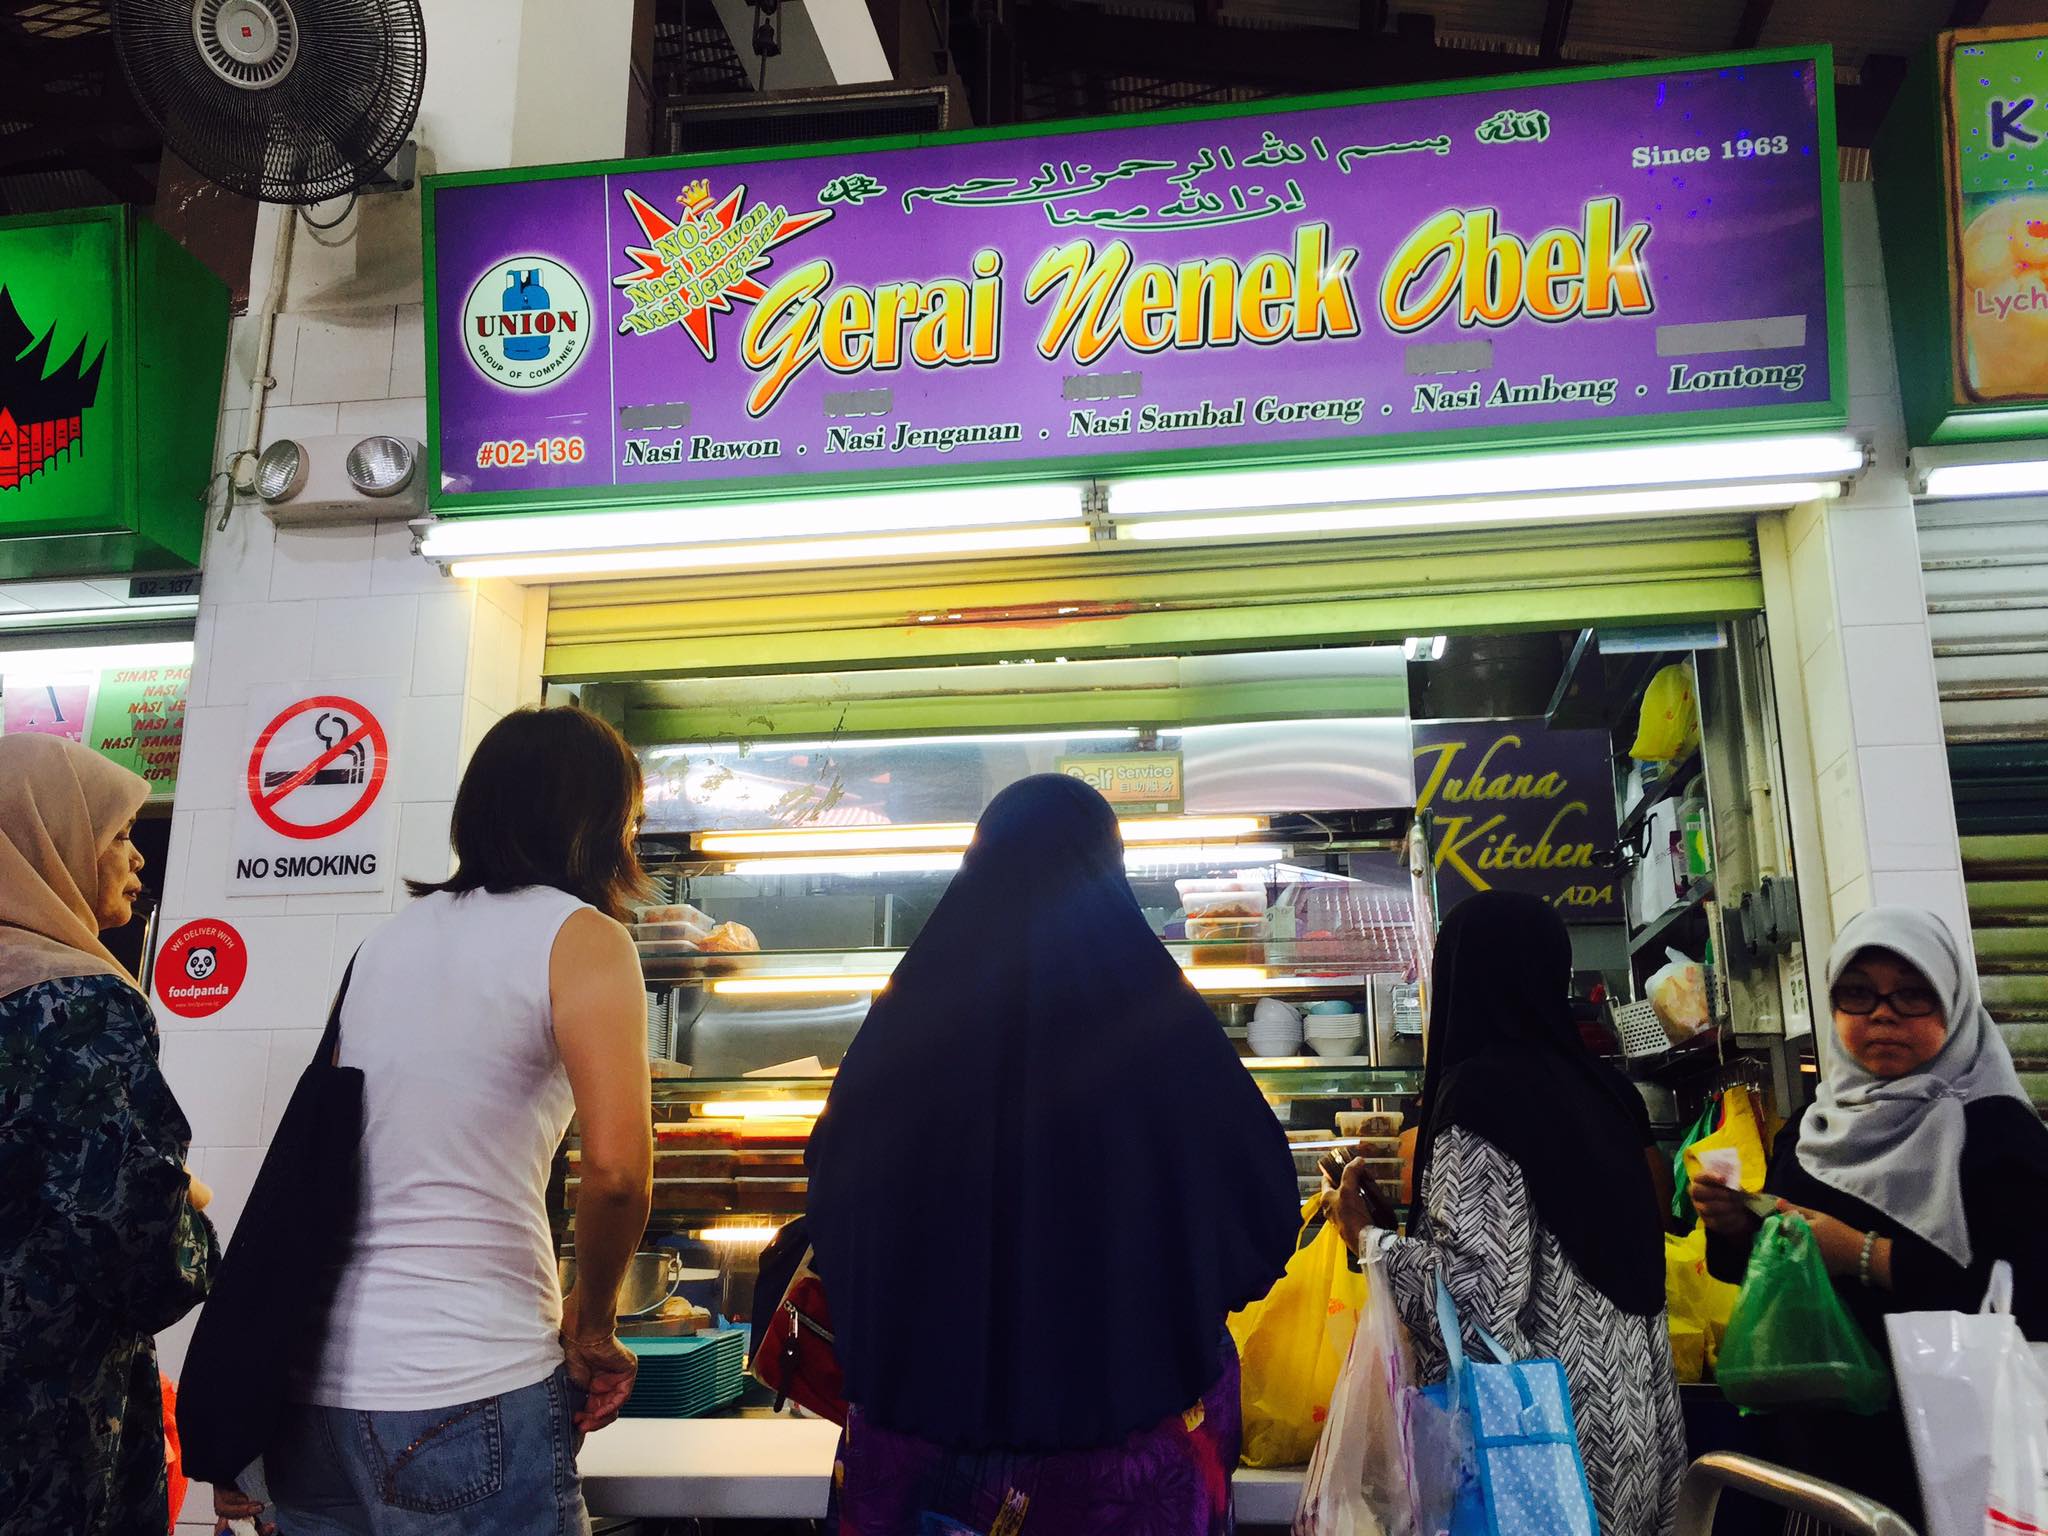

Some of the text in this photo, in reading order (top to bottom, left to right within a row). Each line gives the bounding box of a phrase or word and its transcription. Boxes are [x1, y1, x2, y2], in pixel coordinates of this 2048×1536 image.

[1632, 136, 1789, 169] Since 1963
[654, 210, 722, 262] NO.1
[626, 204, 769, 307] Nasi Rawon
[626, 207, 786, 333] Nasi Jenganan
[742, 198, 1654, 416] Gerai Nenek Obek
[1977, 286, 2048, 320] Lych
[476, 310, 578, 337] UNION
[478, 339, 576, 379] GROUP OF COMPANIES
[1412, 363, 1807, 414] Nasi Ambeng Lontong
[1068, 396, 1364, 438] Nasi Sambal Goreng
[623, 436, 780, 466] Nasi Rawon
[825, 421, 1021, 454] Nasi Jenganan
[479, 438, 584, 467] #02-136
[114, 670, 158, 683] SINAR
[144, 685, 178, 696] NASI
[128, 701, 163, 713] NASI
[134, 718, 168, 730] NASI
[101, 737, 137, 750] NASI
[1117, 765, 1173, 779] Service
[1433, 802, 1594, 892] Kitchen
[237, 854, 376, 879] NO SMOKING
[1553, 885, 1614, 908] ADA
[171, 927, 235, 952] WE DELIVER WITH
[168, 984, 229, 999] foodpanda
